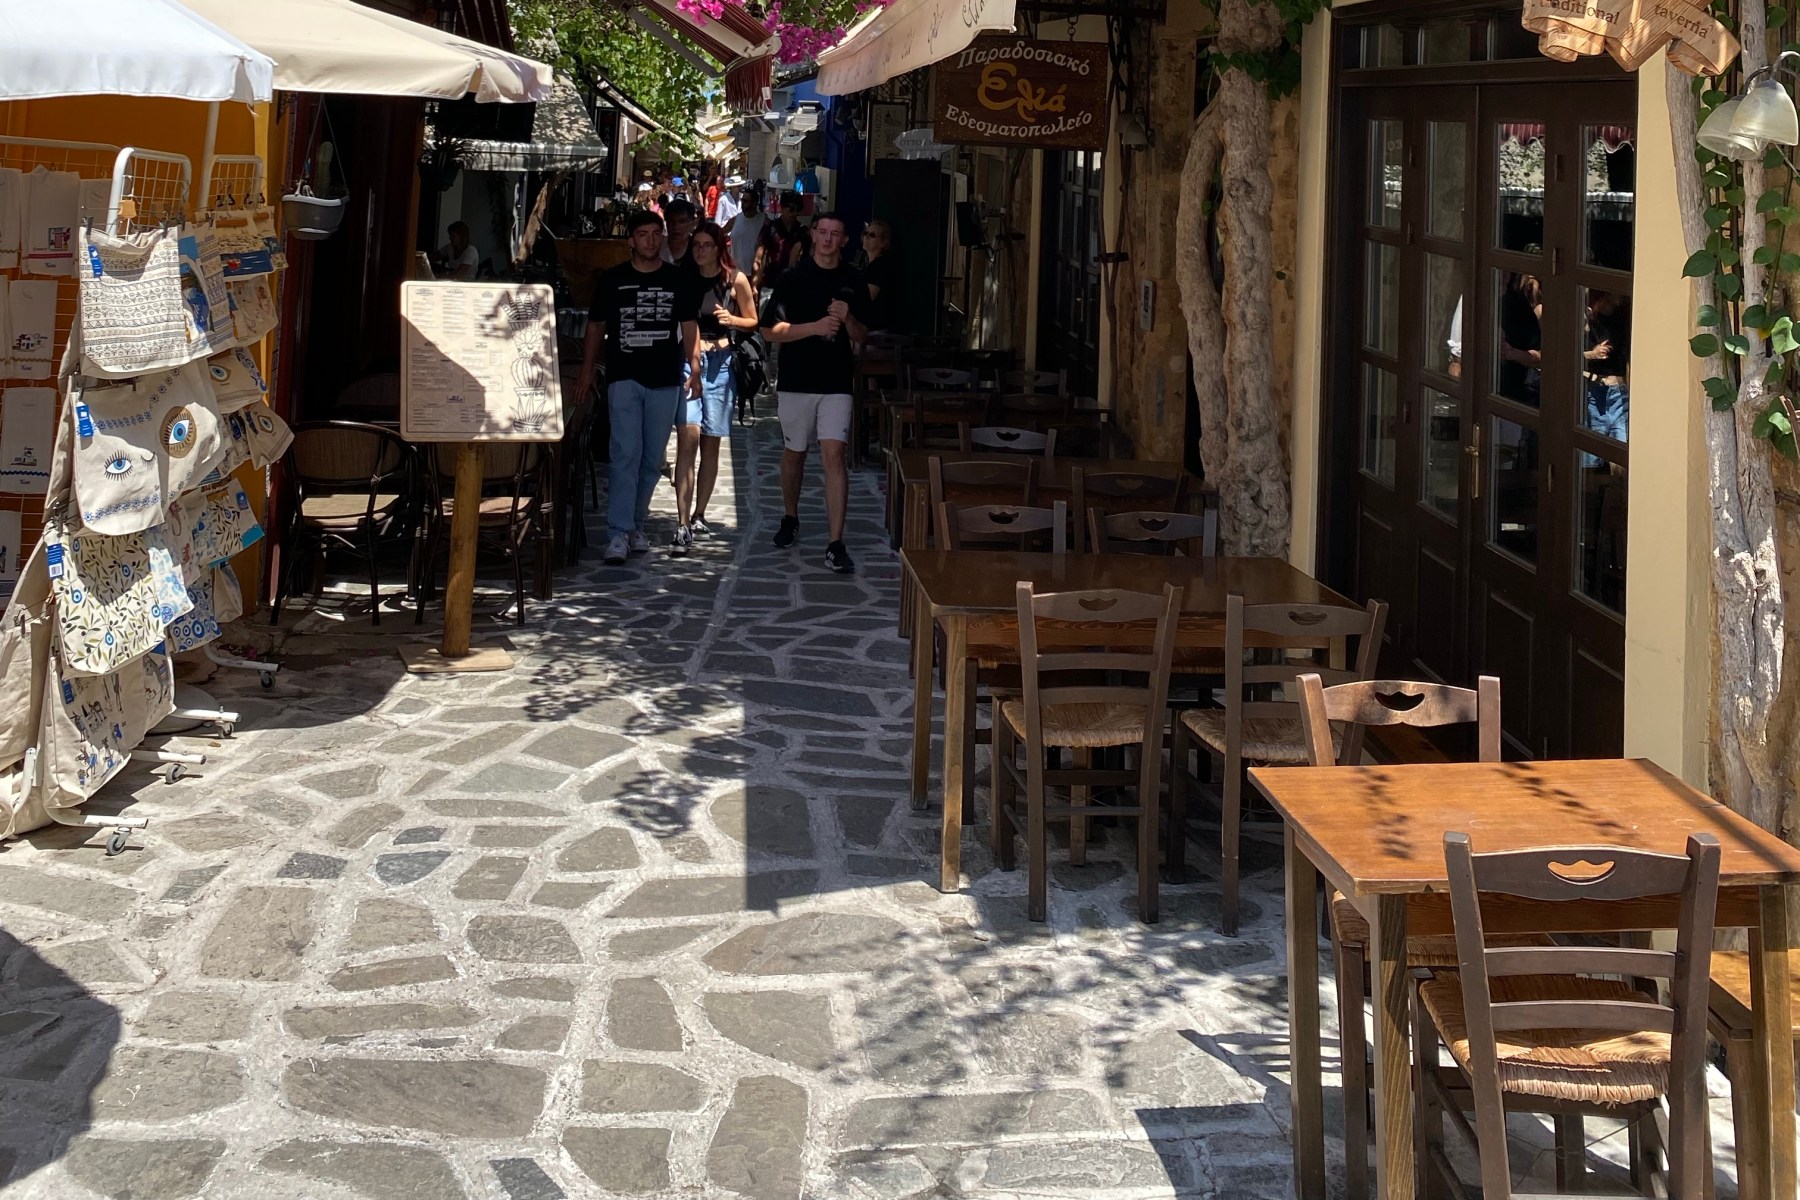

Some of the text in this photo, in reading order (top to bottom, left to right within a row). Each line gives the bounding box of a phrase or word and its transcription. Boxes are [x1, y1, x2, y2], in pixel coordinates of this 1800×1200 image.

[1654, 3, 1709, 39] taverna
[957, 41, 1090, 76] Παραδοσιακό
[977, 62, 1068, 123] Ελιά
[945, 103, 1092, 138] Εδεσματοπωλείο
